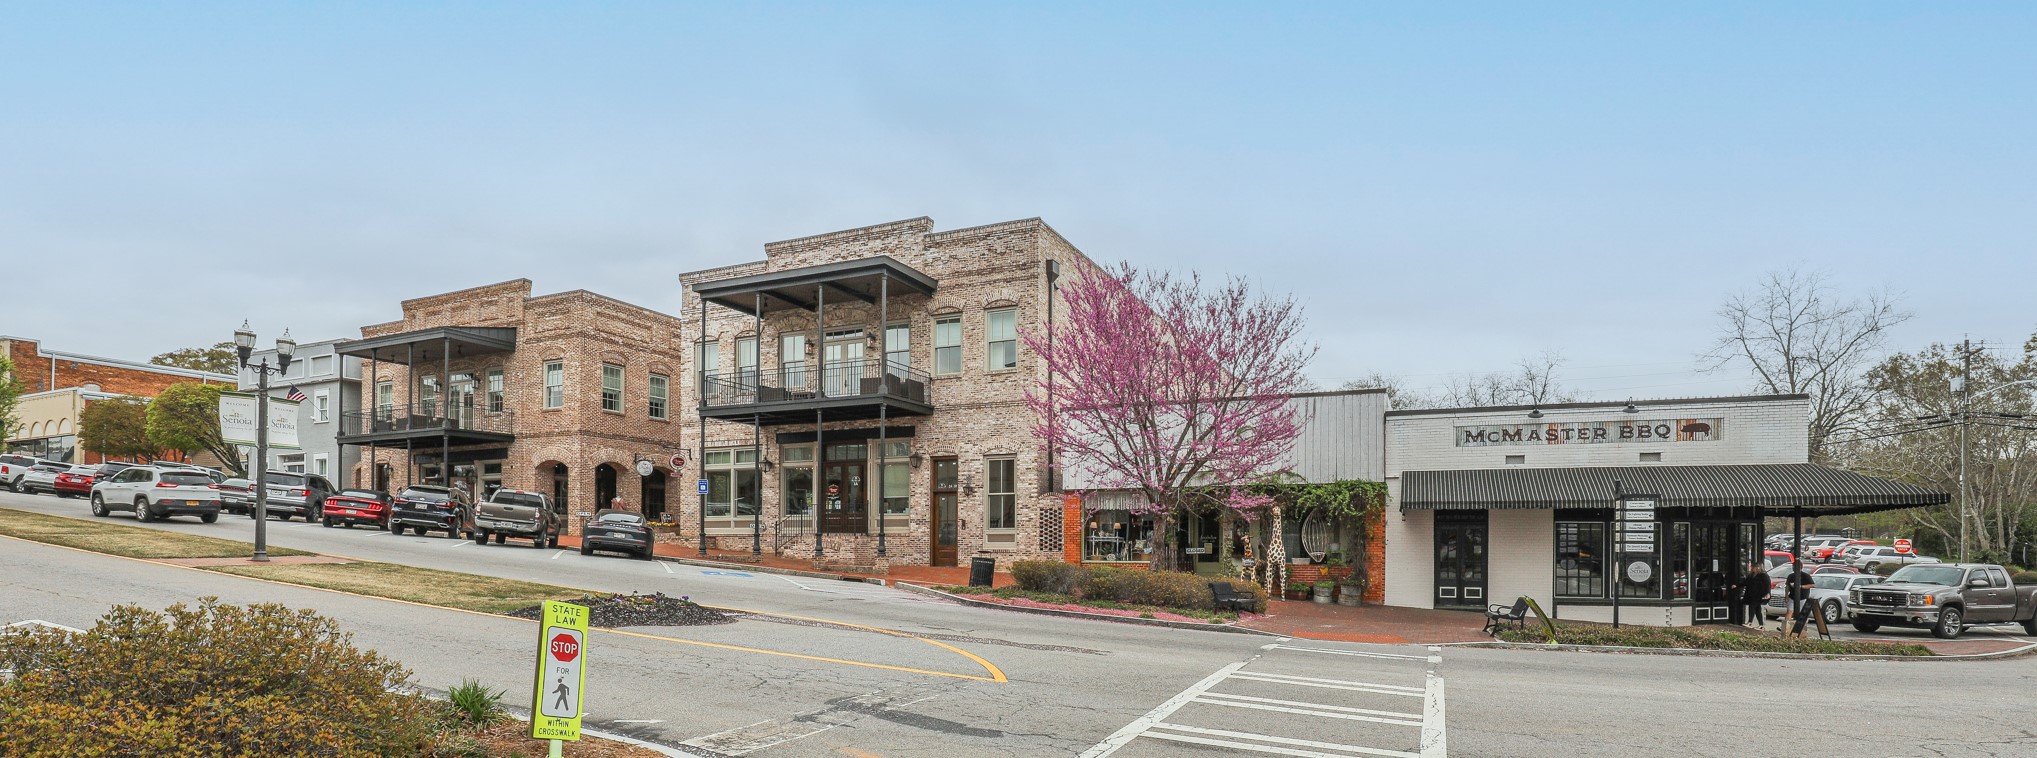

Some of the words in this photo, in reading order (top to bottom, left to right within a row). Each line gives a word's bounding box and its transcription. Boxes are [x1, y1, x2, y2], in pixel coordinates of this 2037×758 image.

[222, 414, 252, 425] Senoia
[271, 419, 295, 430] Senoia
[1618, 424, 1671, 439] BBQ
[552, 605, 581, 616] STATE
[556, 615, 576, 625] LAW
[552, 641, 577, 654] STOP
[538, 727, 575, 737] CROSSWALK
